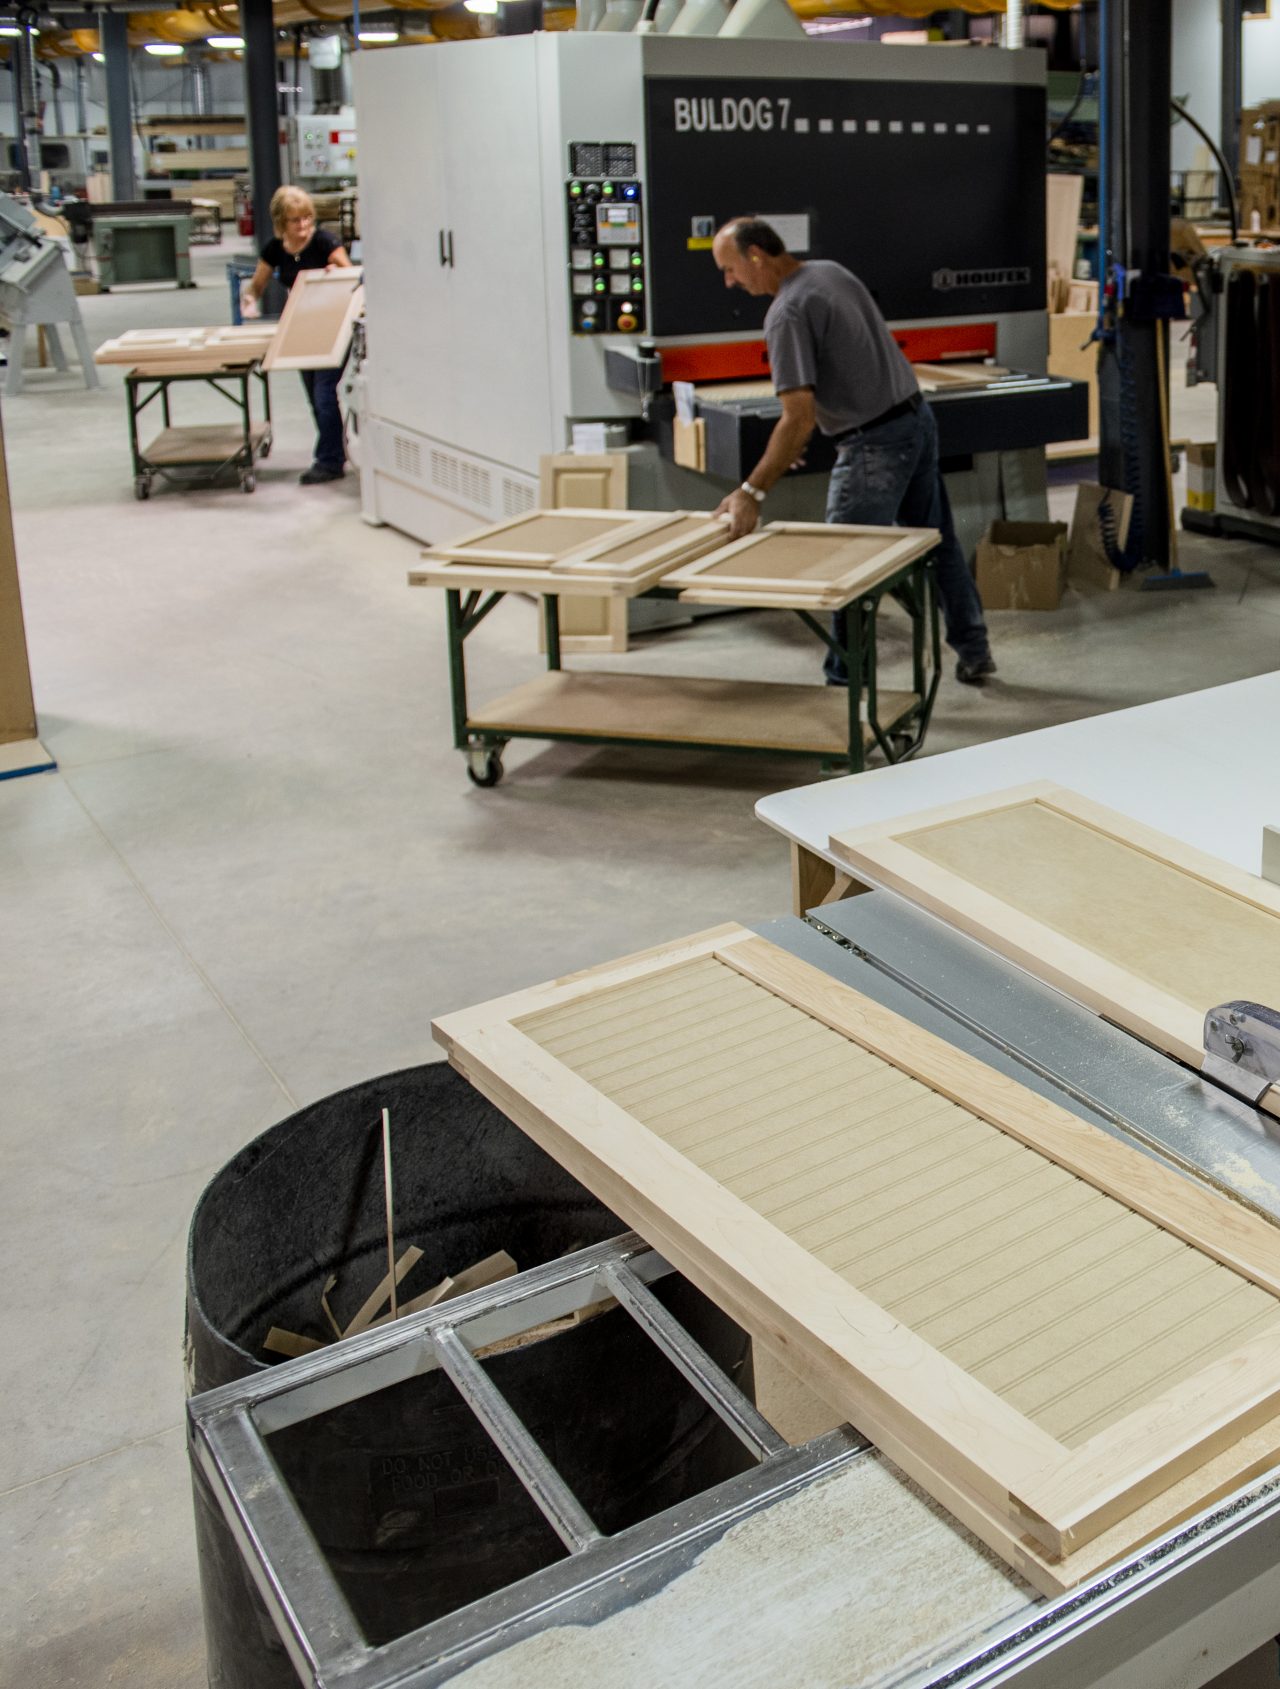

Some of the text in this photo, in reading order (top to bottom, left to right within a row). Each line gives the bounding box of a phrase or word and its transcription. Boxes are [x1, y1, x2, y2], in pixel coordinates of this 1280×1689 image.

[674, 97, 790, 131] BULDOG 7
[418, 1451, 453, 1471] NOT
[392, 1472, 437, 1491] FOOD
